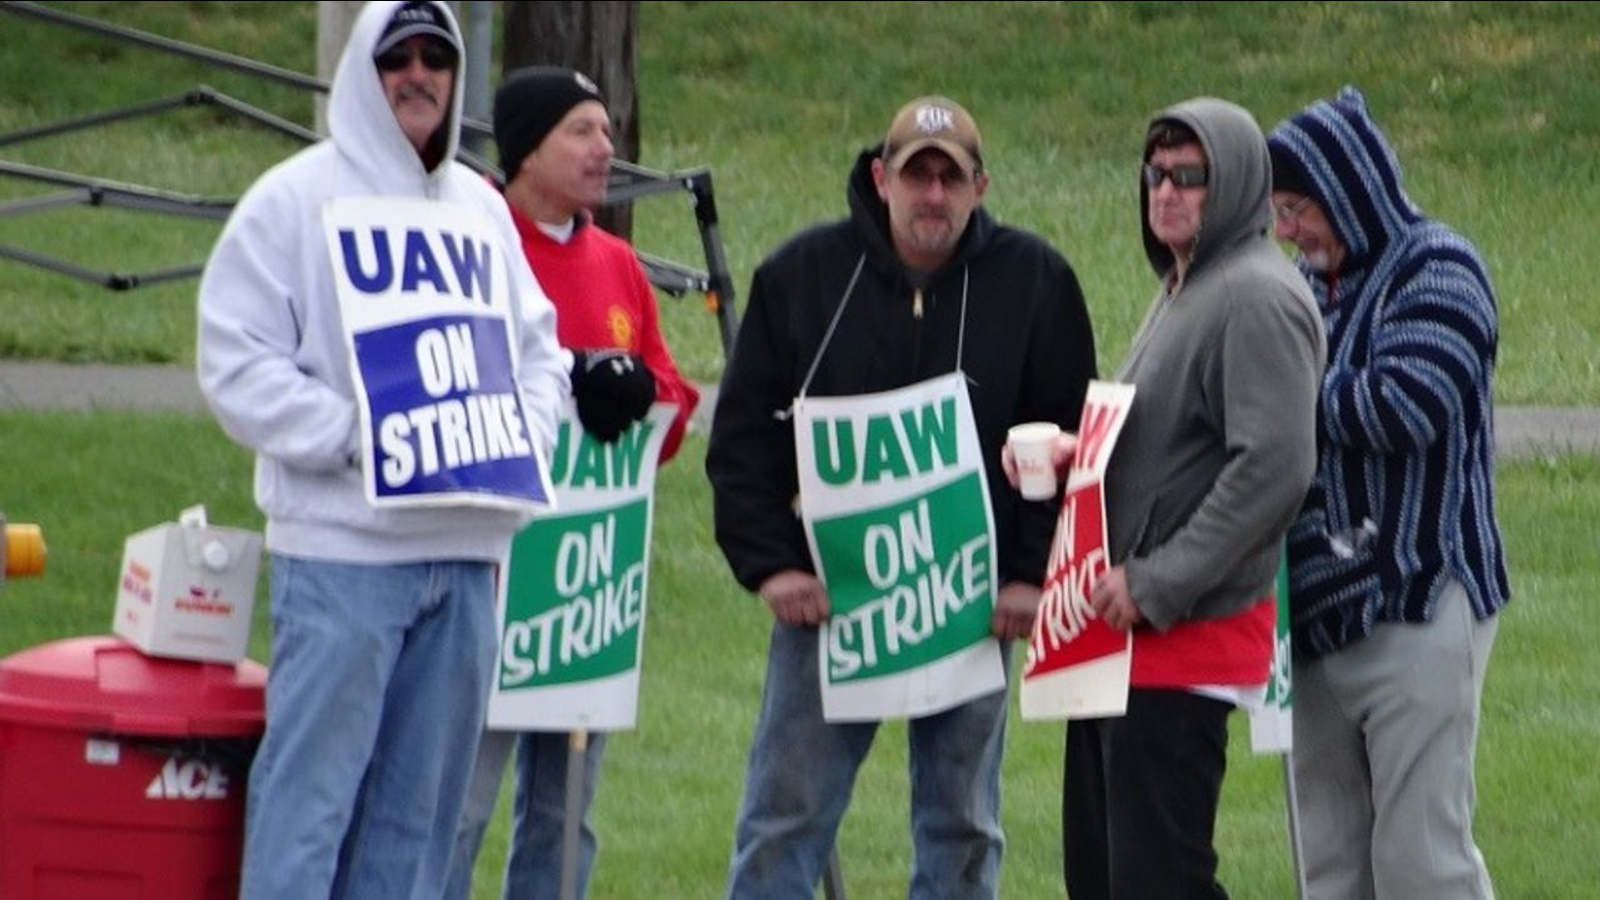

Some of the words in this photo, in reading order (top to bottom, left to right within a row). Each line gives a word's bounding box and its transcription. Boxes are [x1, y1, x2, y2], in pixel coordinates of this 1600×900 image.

[337, 228, 493, 306] UAW
[415, 322, 480, 399] ON
[379, 392, 531, 489] STRIKE
[812, 396, 959, 487] UAW
[555, 512, 616, 598] ON
[864, 498, 935, 590] ON
[502, 561, 643, 687] STRIKE
[828, 533, 990, 680] STRIKE
[145, 756, 229, 800] ACE
